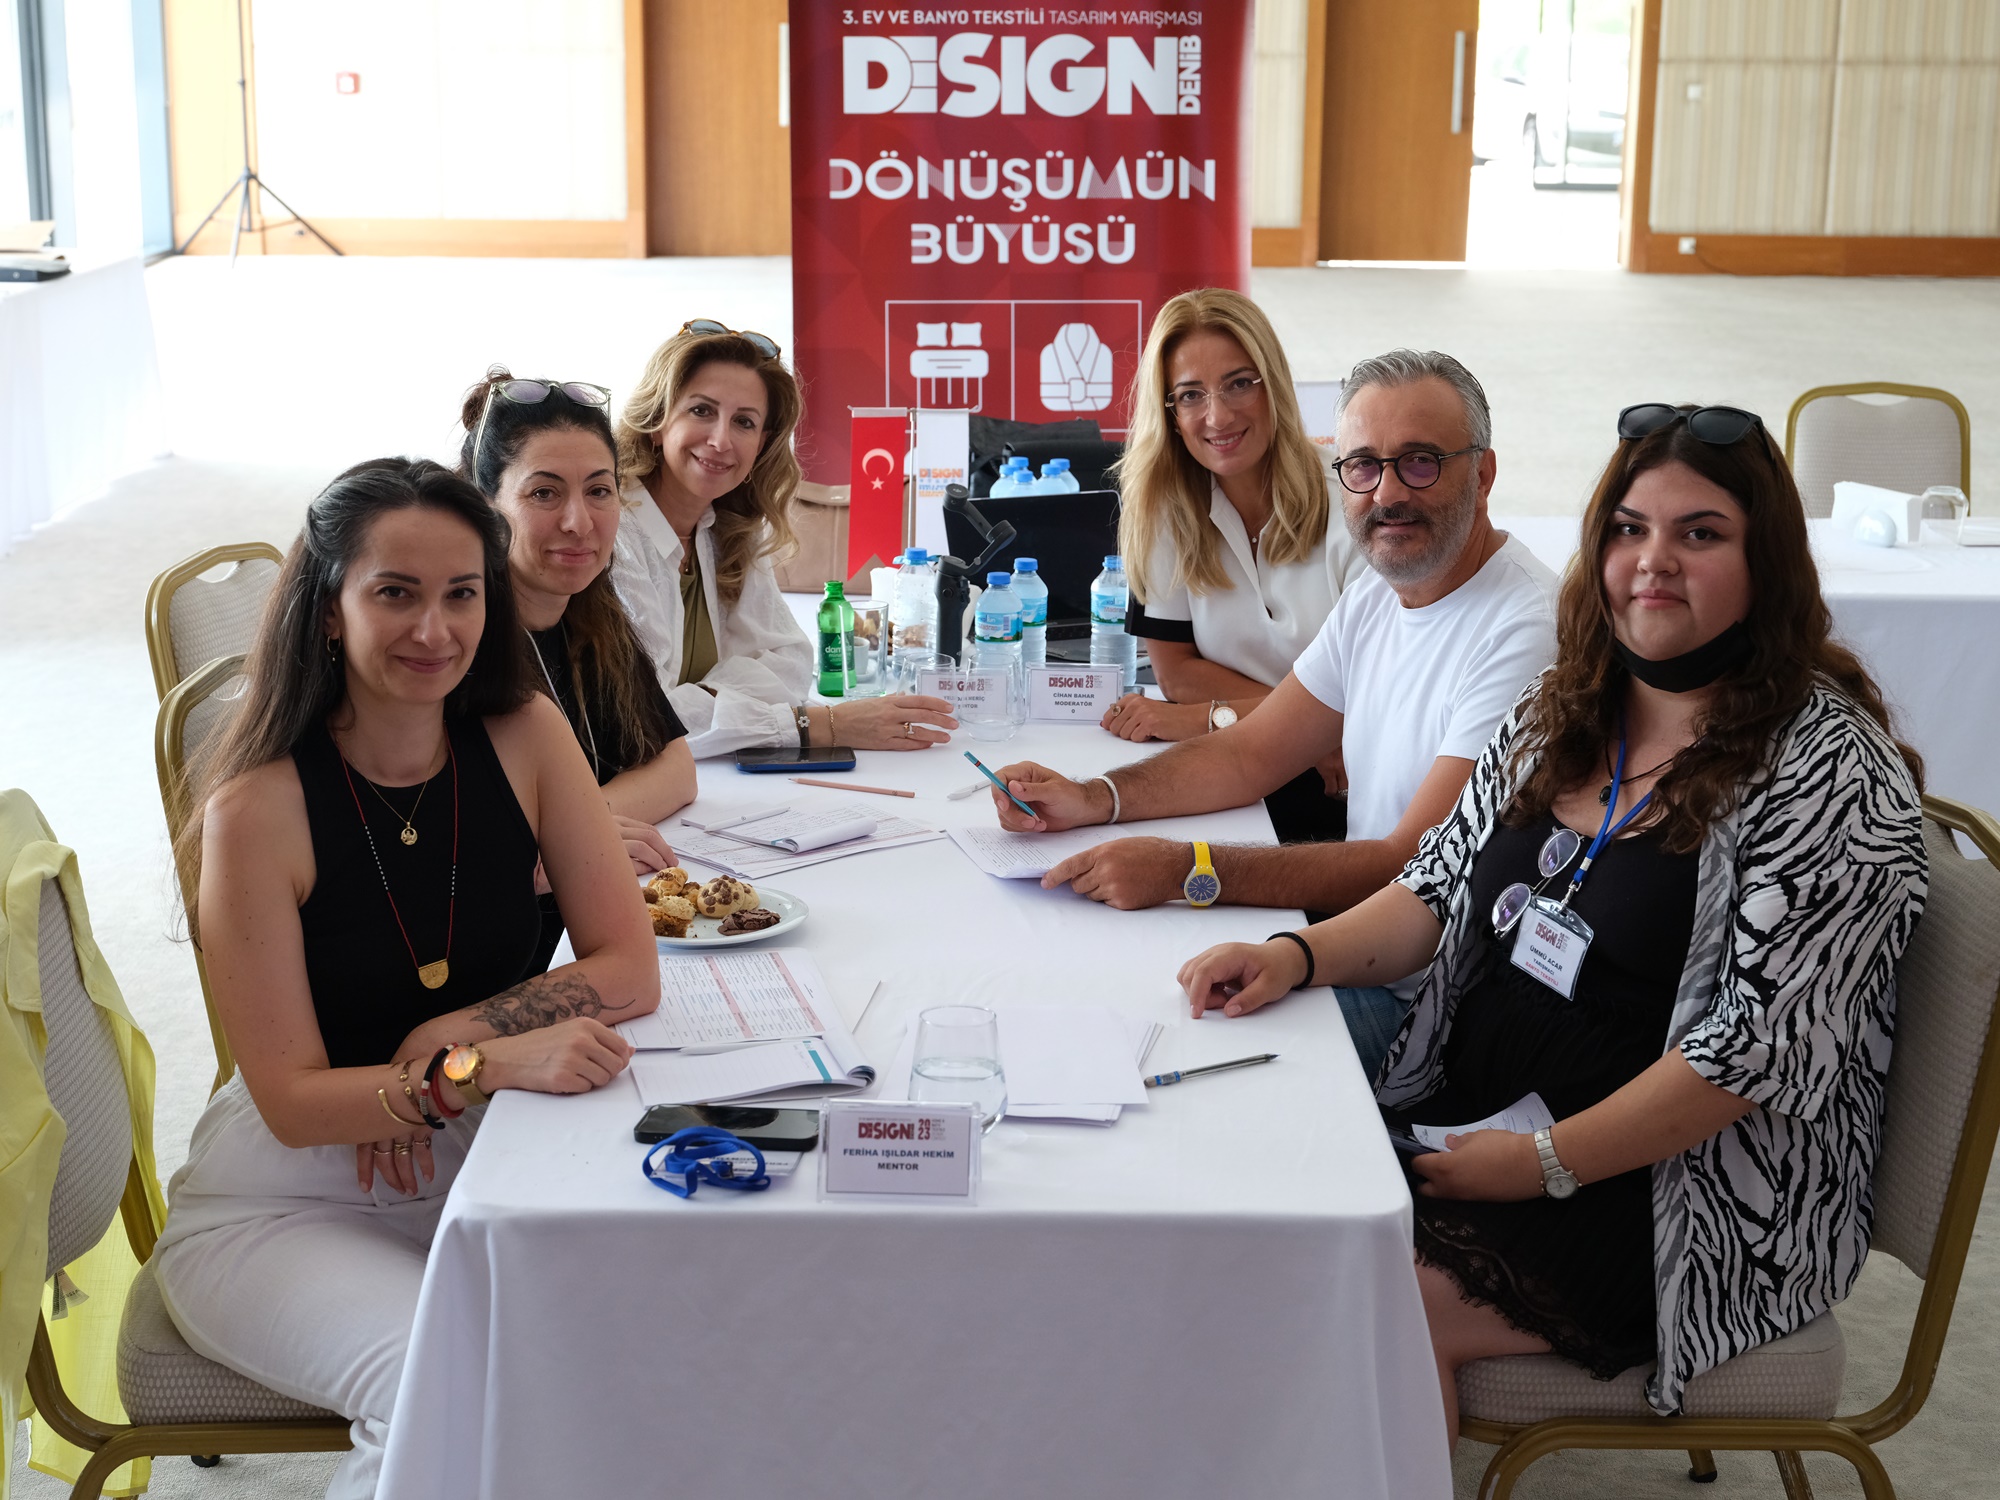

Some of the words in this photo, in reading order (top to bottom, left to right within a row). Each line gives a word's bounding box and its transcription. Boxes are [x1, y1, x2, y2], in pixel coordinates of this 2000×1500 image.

[842, 9, 858, 25] 3.
[862, 9, 884, 25] EV
[887, 9, 910, 25] VE
[913, 9, 969, 25] BANYO
[972, 7, 1044, 25] TEKSTİLİ
[1048, 10, 1117, 25] TASARIM
[1120, 10, 1203, 28] YARIŞMASI
[842, 32, 1178, 118] DESIGN
[829, 150, 1216, 213] DÖNÜŞÜMÜN
[911, 214, 1136, 265] BÜYÜSÜ
[1547, 958, 1563, 971] ACAR
[918, 1118, 931, 1128] 20
[858, 1122, 911, 1140] DESIGN
[917, 1127, 931, 1140] 23
[843, 1147, 879, 1157] FERİHA
[881, 1149, 920, 1158] IŞILDAR
[922, 1149, 955, 1158] HEKİM
[877, 1162, 919, 1171] MENTOR
